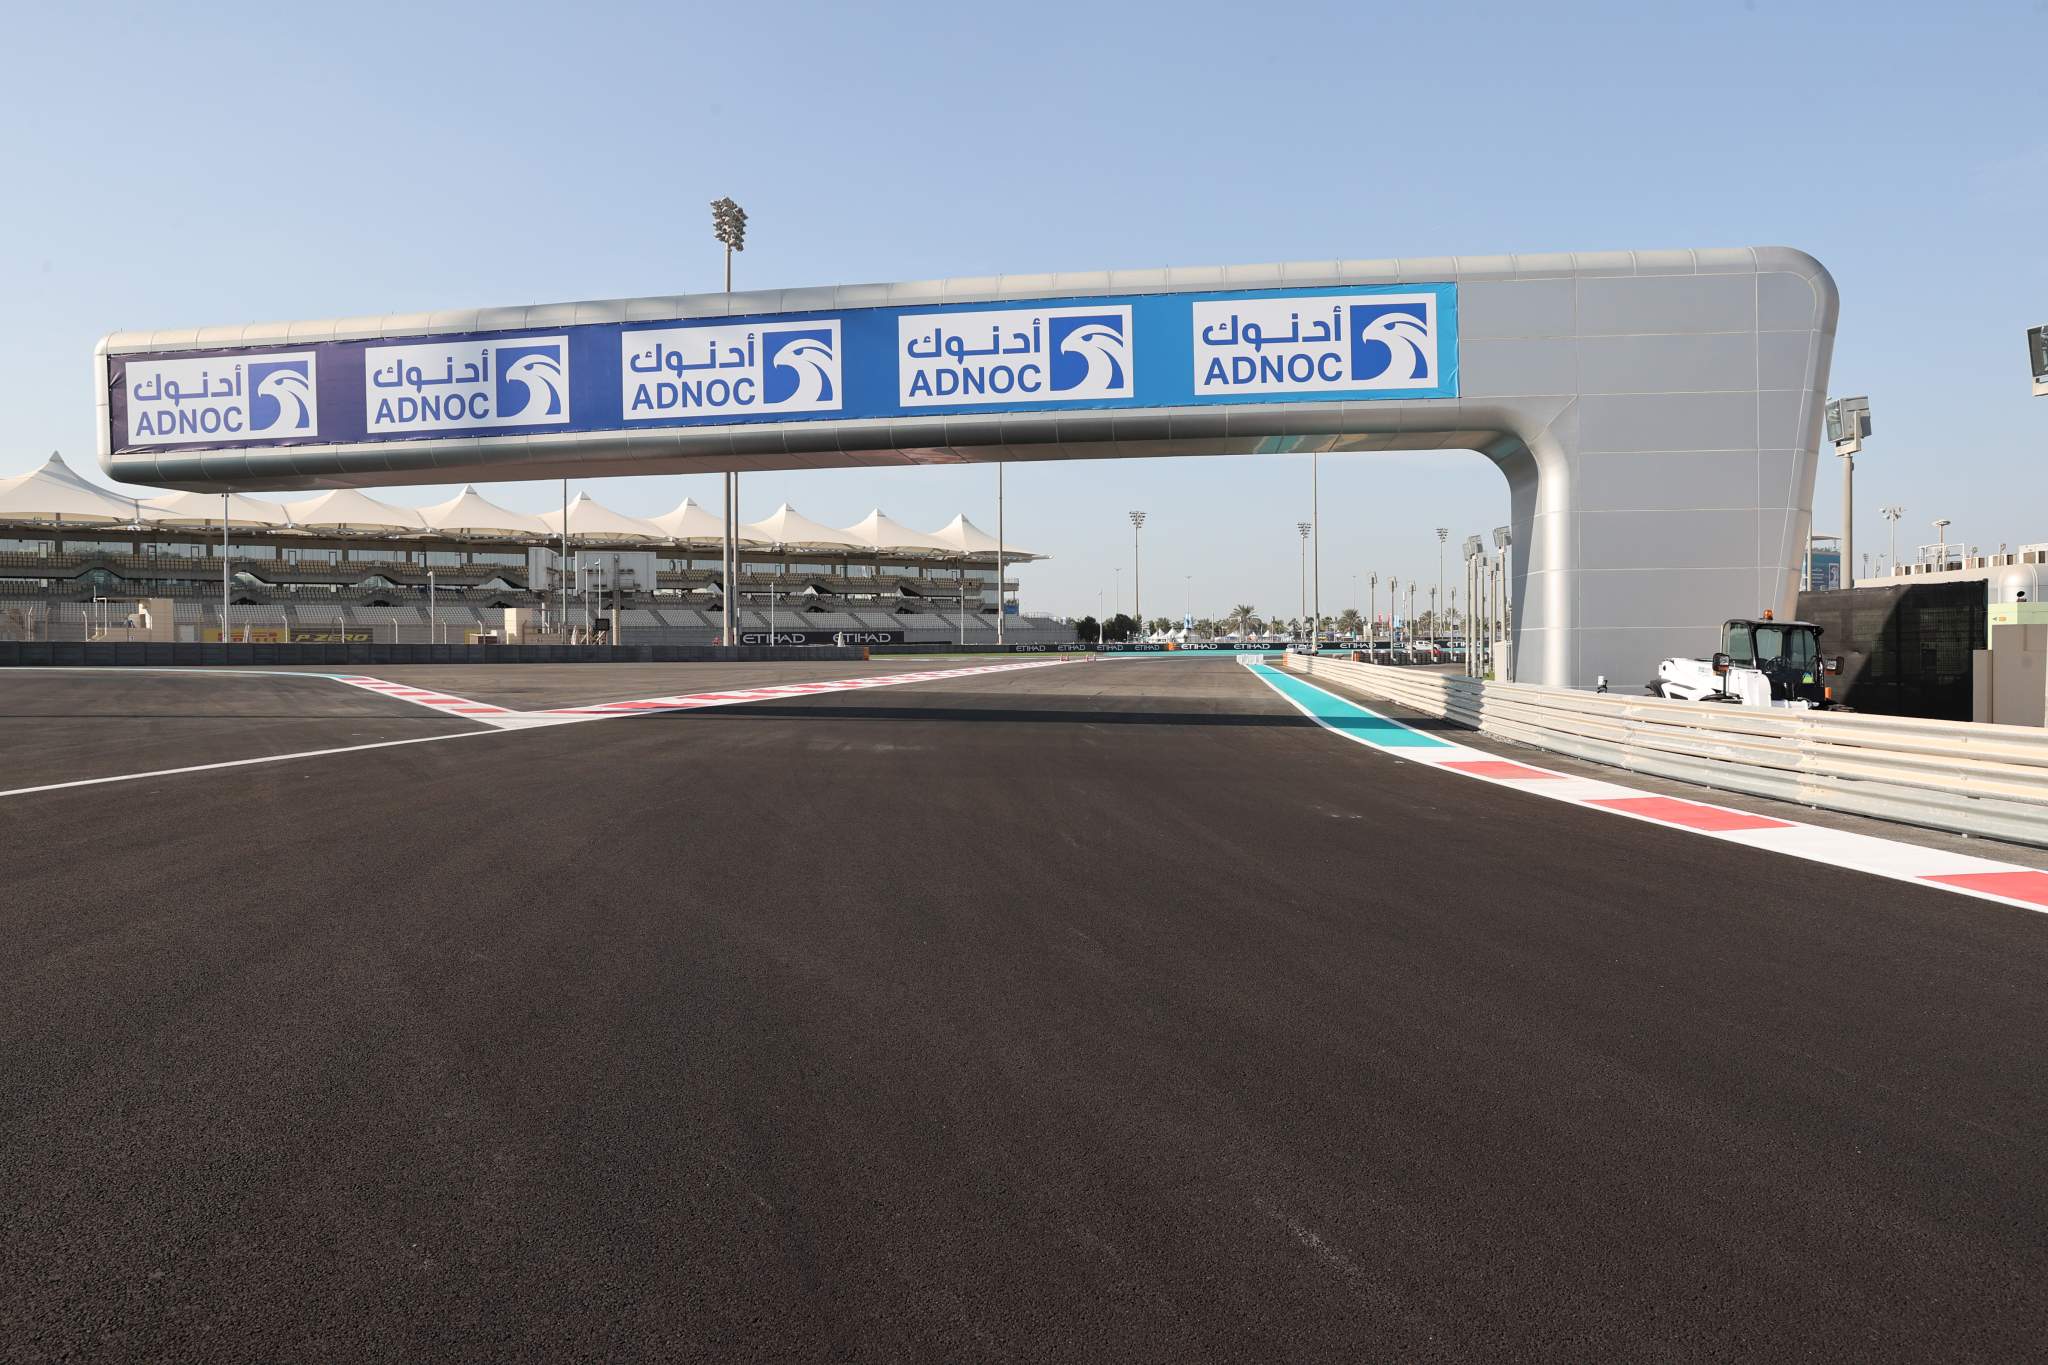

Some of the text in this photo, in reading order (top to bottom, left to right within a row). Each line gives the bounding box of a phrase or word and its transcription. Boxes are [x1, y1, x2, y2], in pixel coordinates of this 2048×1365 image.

[908, 317, 1041, 364] أدنوك
[1203, 307, 1342, 351] أدنوك
[374, 349, 489, 393] أدنوك
[630, 333, 755, 378] أدنوك
[1205, 352, 1343, 384] ADNOC
[134, 365, 242, 406] أدنوك
[632, 378, 755, 410] ADNOC
[911, 363, 1041, 396] ADNOC
[136, 407, 243, 436] ADNOC
[375, 392, 489, 424] ADNOC
[743, 633, 806, 644] ETIHAD
